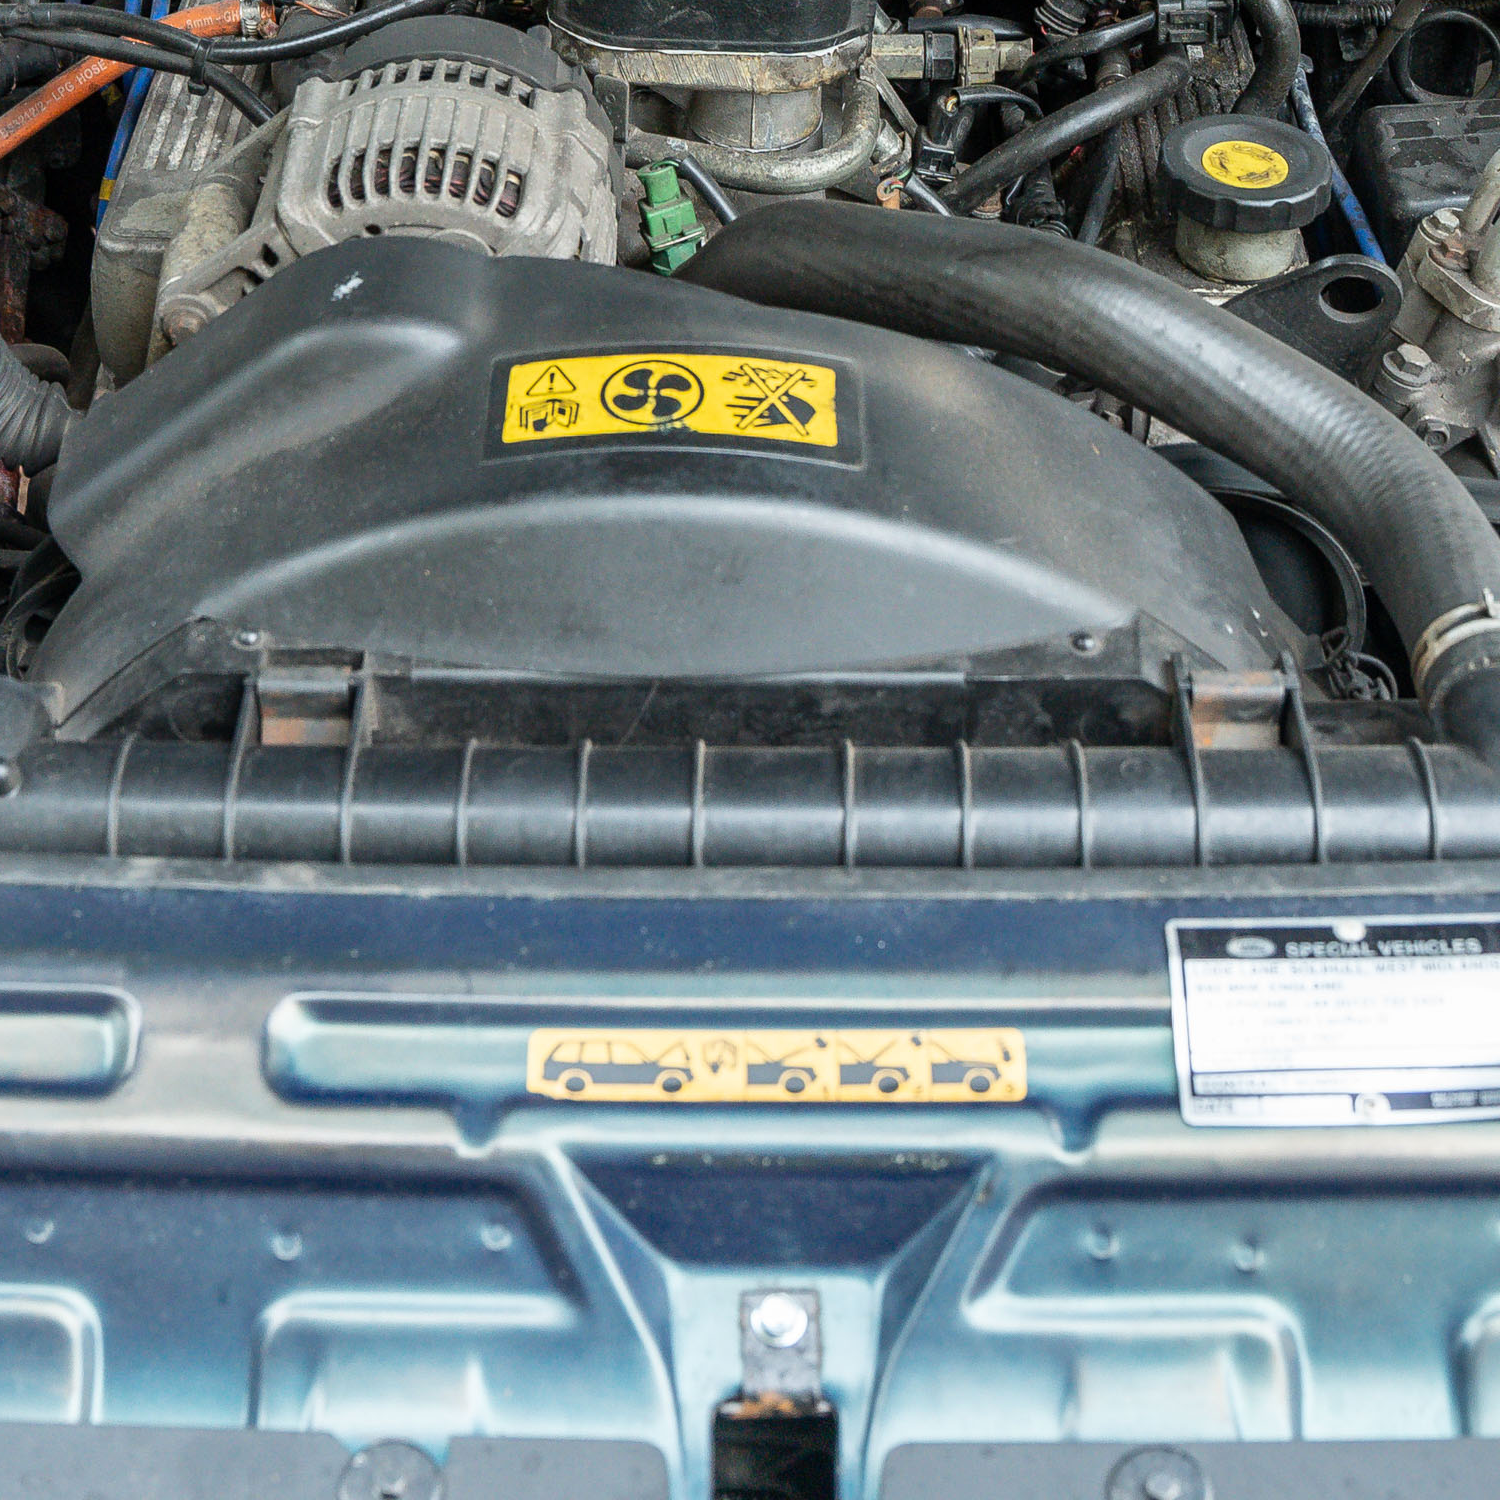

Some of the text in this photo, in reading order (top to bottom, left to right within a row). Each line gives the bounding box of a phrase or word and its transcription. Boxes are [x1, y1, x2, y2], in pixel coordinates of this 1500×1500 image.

[51, 81, 76, 101] LPG
[75, 59, 109, 85] HOSE
[1284, 940, 1376, 958] SPECIAL
[1377, 937, 1483, 957] VEHICLES
